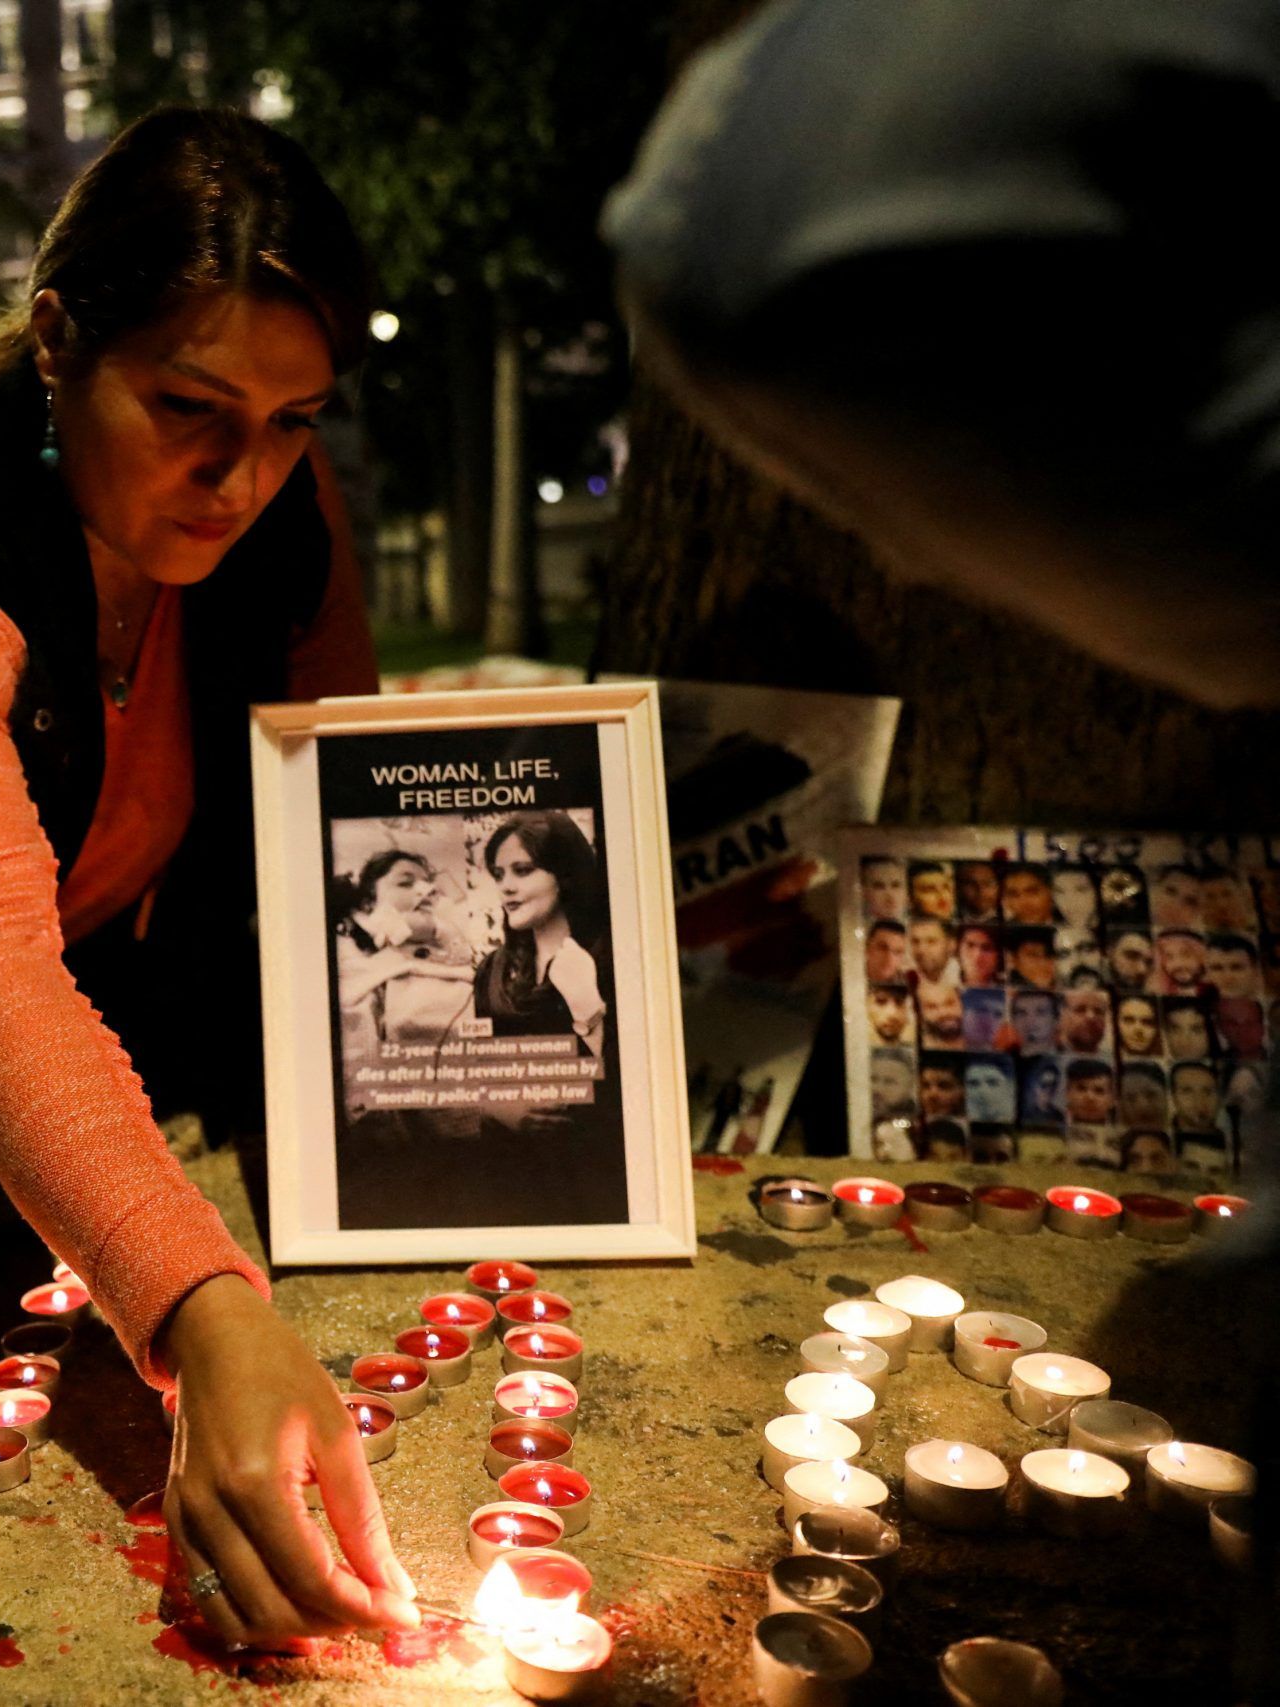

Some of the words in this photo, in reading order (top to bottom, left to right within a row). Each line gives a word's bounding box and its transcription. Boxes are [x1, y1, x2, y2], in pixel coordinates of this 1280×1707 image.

[371, 762, 486, 786] WOMAN,
[494, 758, 560, 780] LIFE,
[399, 785, 536, 810] FREEDOM
[466, 1039, 517, 1055] Iranian
[519, 1041, 572, 1053] woman
[387, 1065, 422, 1082] after
[467, 1062, 526, 1080] severely
[527, 1061, 578, 1077] beaten
[579, 1059, 598, 1077] by
[488, 1089, 521, 1101] over
[522, 1085, 559, 1102] hijab
[561, 1084, 588, 1099] law
